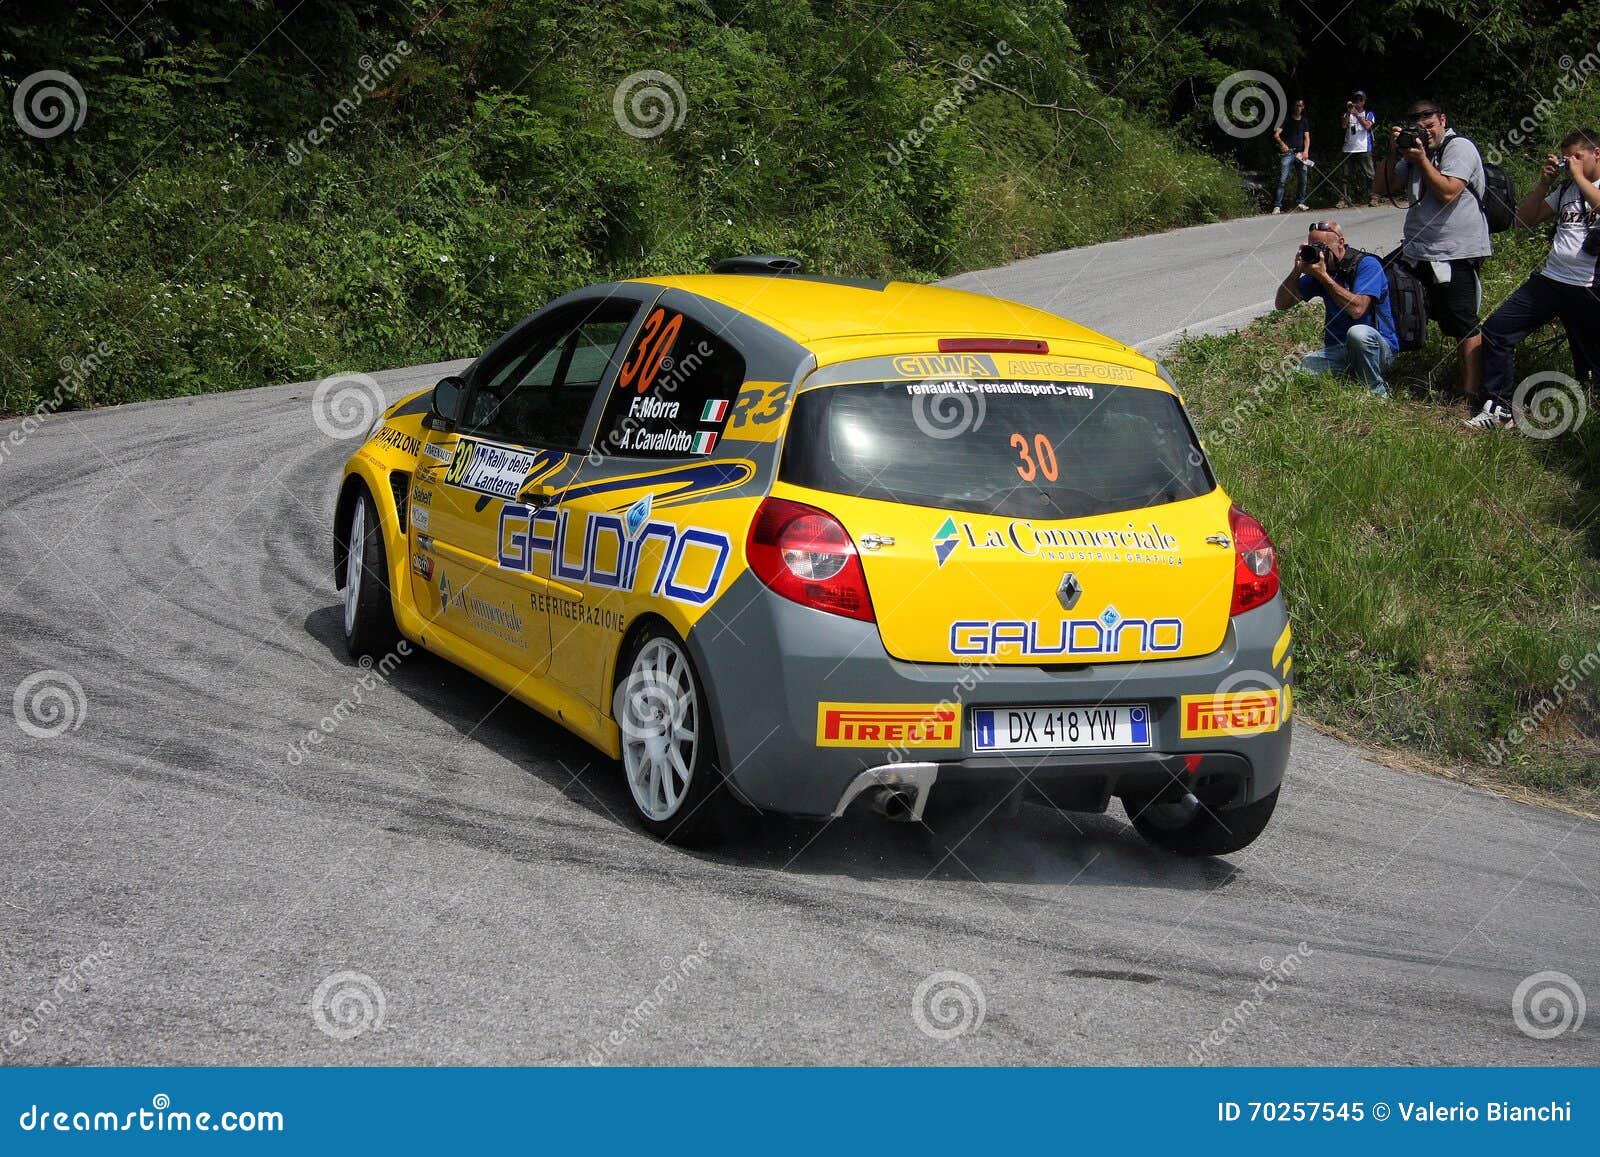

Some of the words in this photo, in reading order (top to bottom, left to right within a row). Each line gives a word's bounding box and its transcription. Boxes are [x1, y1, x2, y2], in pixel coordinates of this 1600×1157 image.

[619, 308, 684, 394] 30
[892, 354, 990, 378] GIMA
[1008, 360, 1136, 381] AUTOSPORT
[628, 396, 680, 419] F.Morra
[728, 384, 793, 428] R3
[447, 441, 474, 484] 30
[485, 448, 508, 473] Rally
[507, 454, 531, 475] della
[1010, 433, 1059, 482] 30
[475, 470, 520, 496] Lanterna
[962, 522, 1008, 549] La
[1008, 520, 1180, 556] Commerciale
[1040, 551, 1120, 562] INDUSTRIA
[1126, 553, 1183, 566] GRAFICA
[530, 593, 626, 633] REFRIGERAZIONE
[824, 710, 956, 741] PIRELLI
[1008, 711, 1038, 743] DX
[1043, 711, 1080, 743] 418
[1084, 710, 1117, 741] YW
[1186, 695, 1279, 732] PIRELLI
